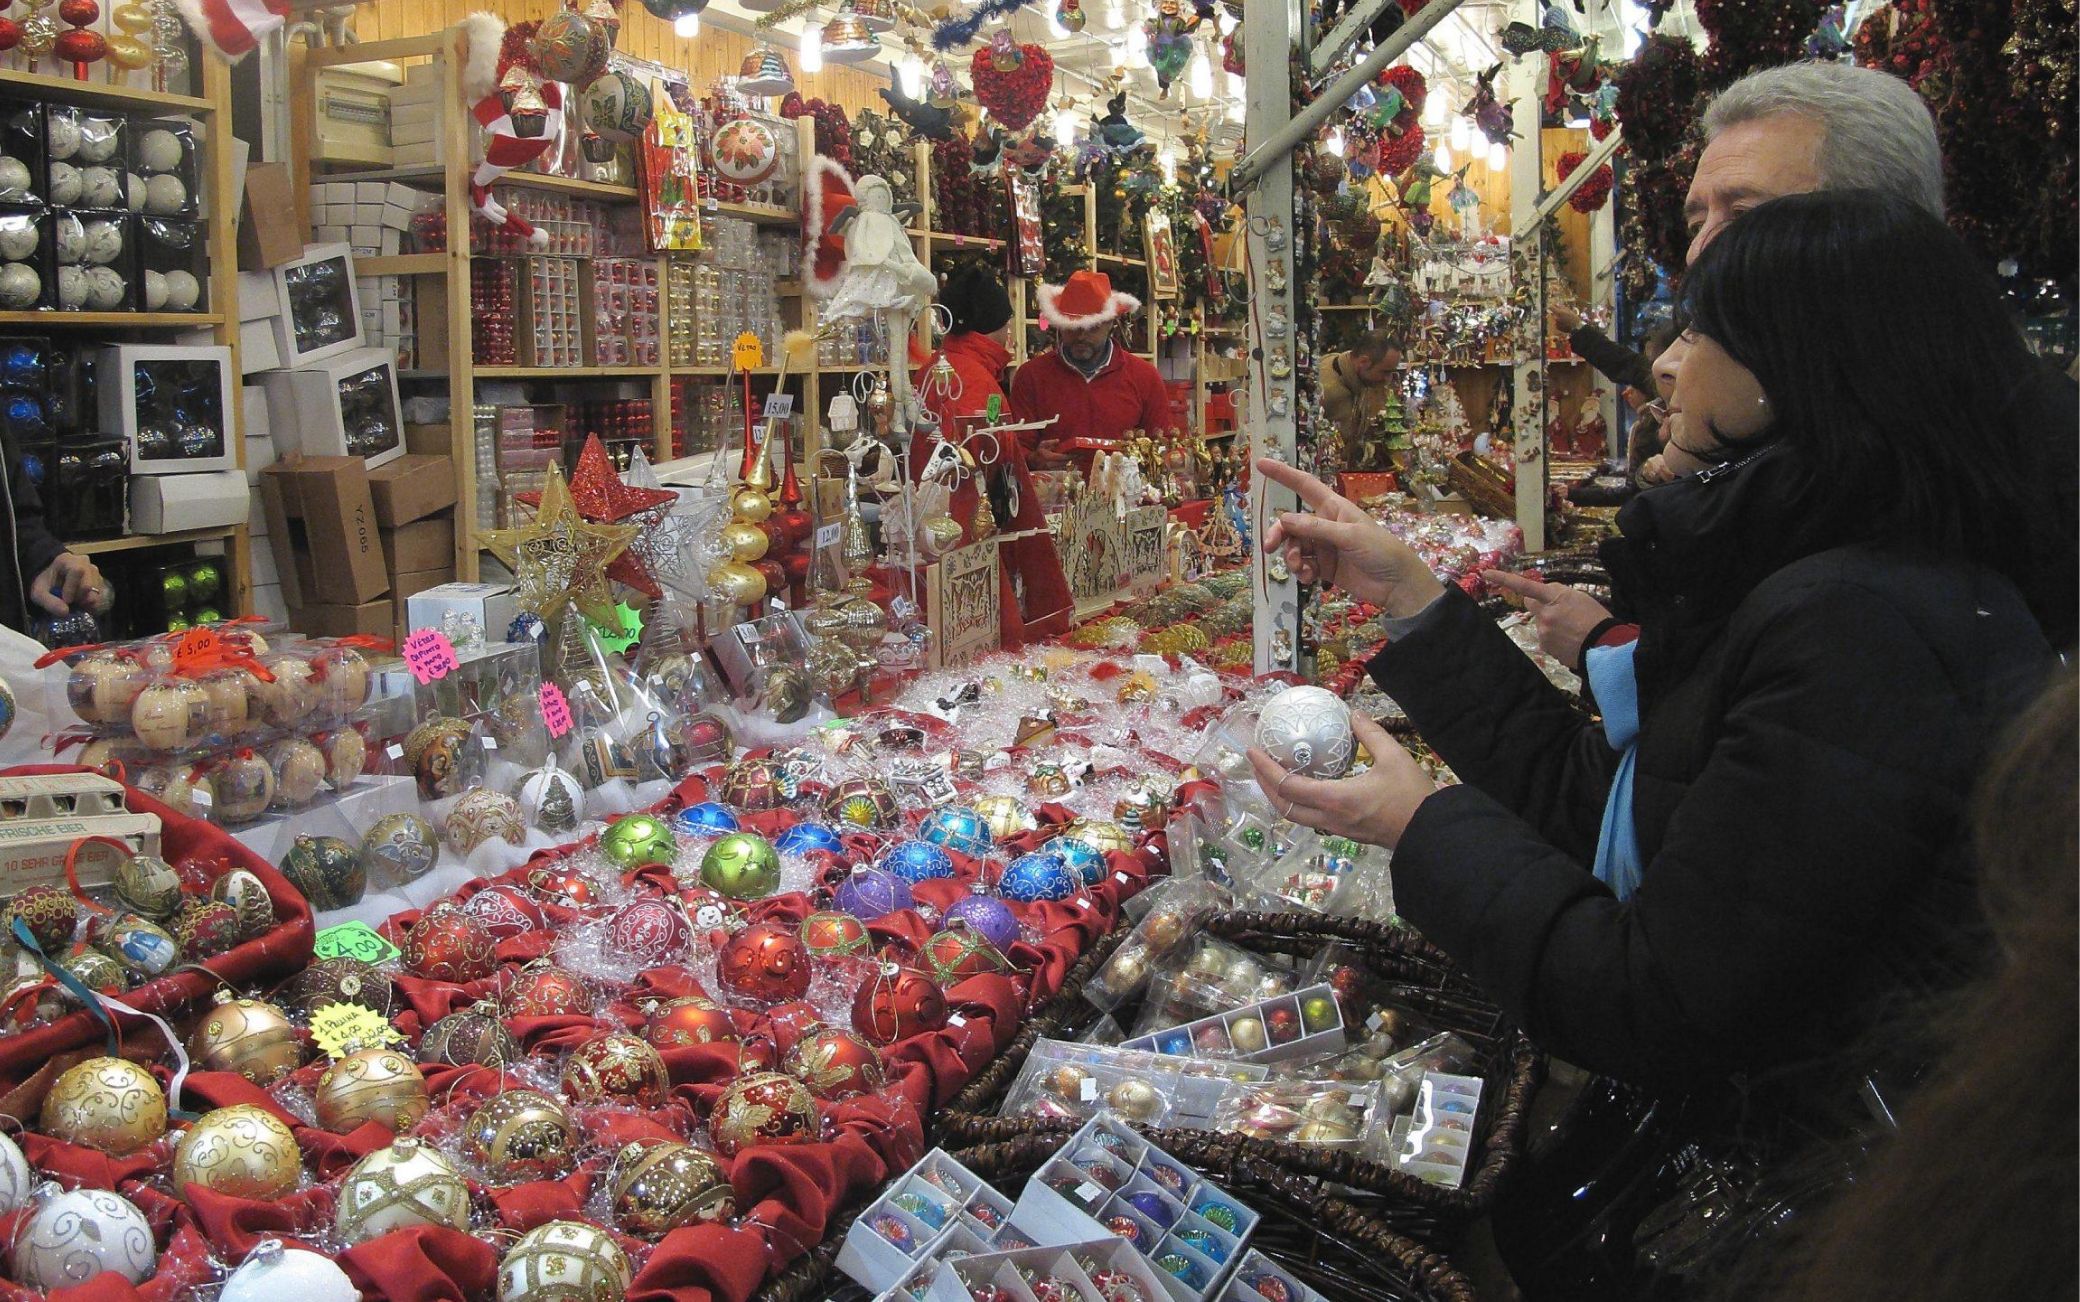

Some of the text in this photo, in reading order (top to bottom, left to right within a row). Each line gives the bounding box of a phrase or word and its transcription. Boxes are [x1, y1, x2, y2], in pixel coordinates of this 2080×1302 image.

[767, 401, 790, 415] 15,00
[0, 822, 88, 839] FRISCHE EIER
[4, 861, 18, 872] 10
